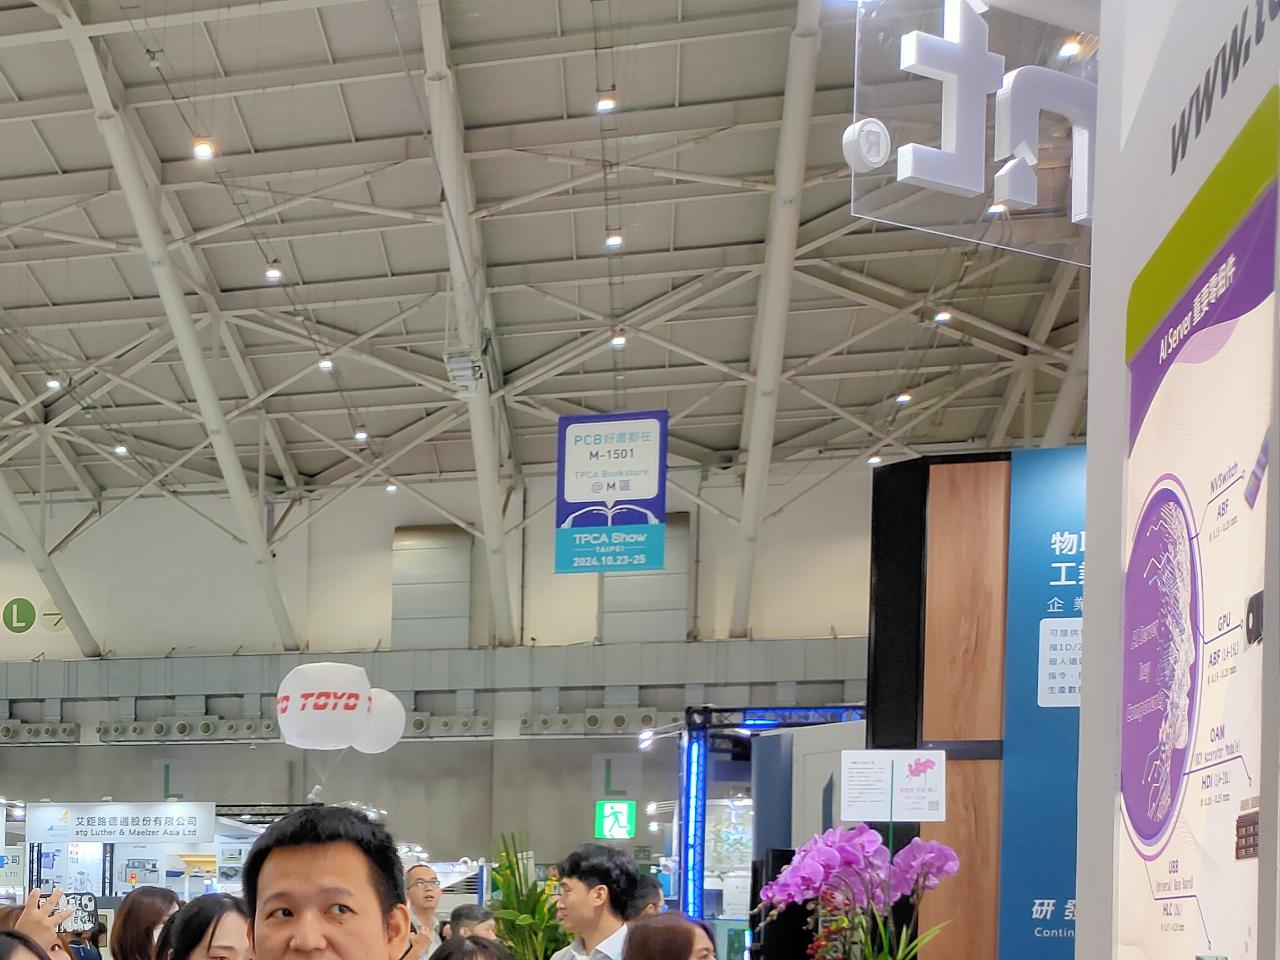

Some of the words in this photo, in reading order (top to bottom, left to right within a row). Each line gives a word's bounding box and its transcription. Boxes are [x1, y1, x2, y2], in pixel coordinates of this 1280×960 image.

[589, 448, 634, 460] M-1501
[606, 483, 616, 491] M
[573, 533, 609, 545] TPCA
[611, 532, 647, 543] Show
[12, 604, 26, 627] L
[300, 691, 360, 711] TOYO
[605, 759, 627, 796] L
